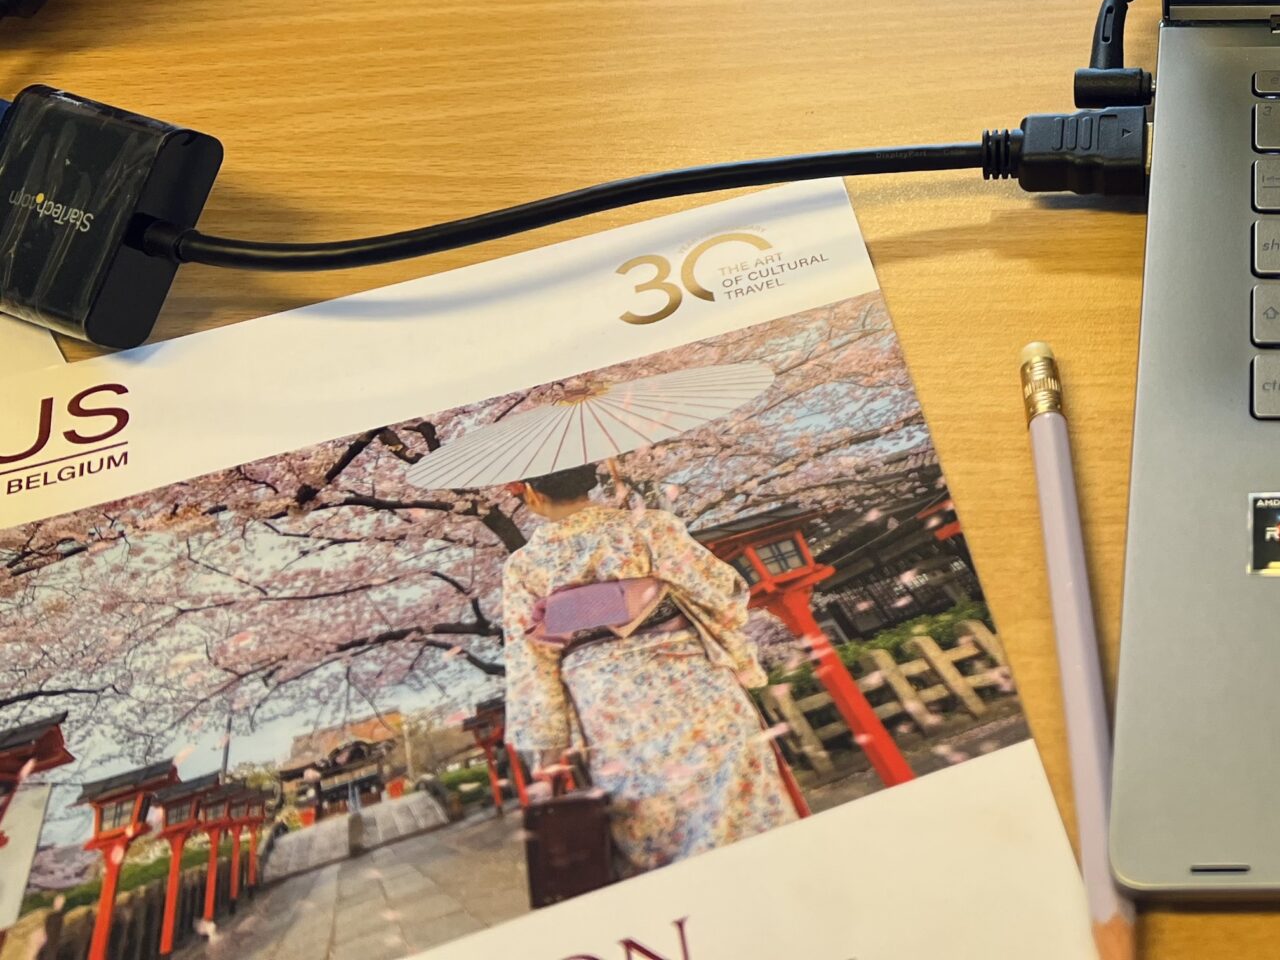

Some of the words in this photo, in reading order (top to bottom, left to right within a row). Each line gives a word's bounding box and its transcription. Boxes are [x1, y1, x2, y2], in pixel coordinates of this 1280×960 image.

[718, 261, 749, 277] THE
[754, 252, 783, 268] ART
[722, 274, 742, 289] OF
[748, 253, 829, 282] CULTURAL
[723, 278, 785, 301] TRAVEL
[6, 451, 129, 496] BELGIUM
